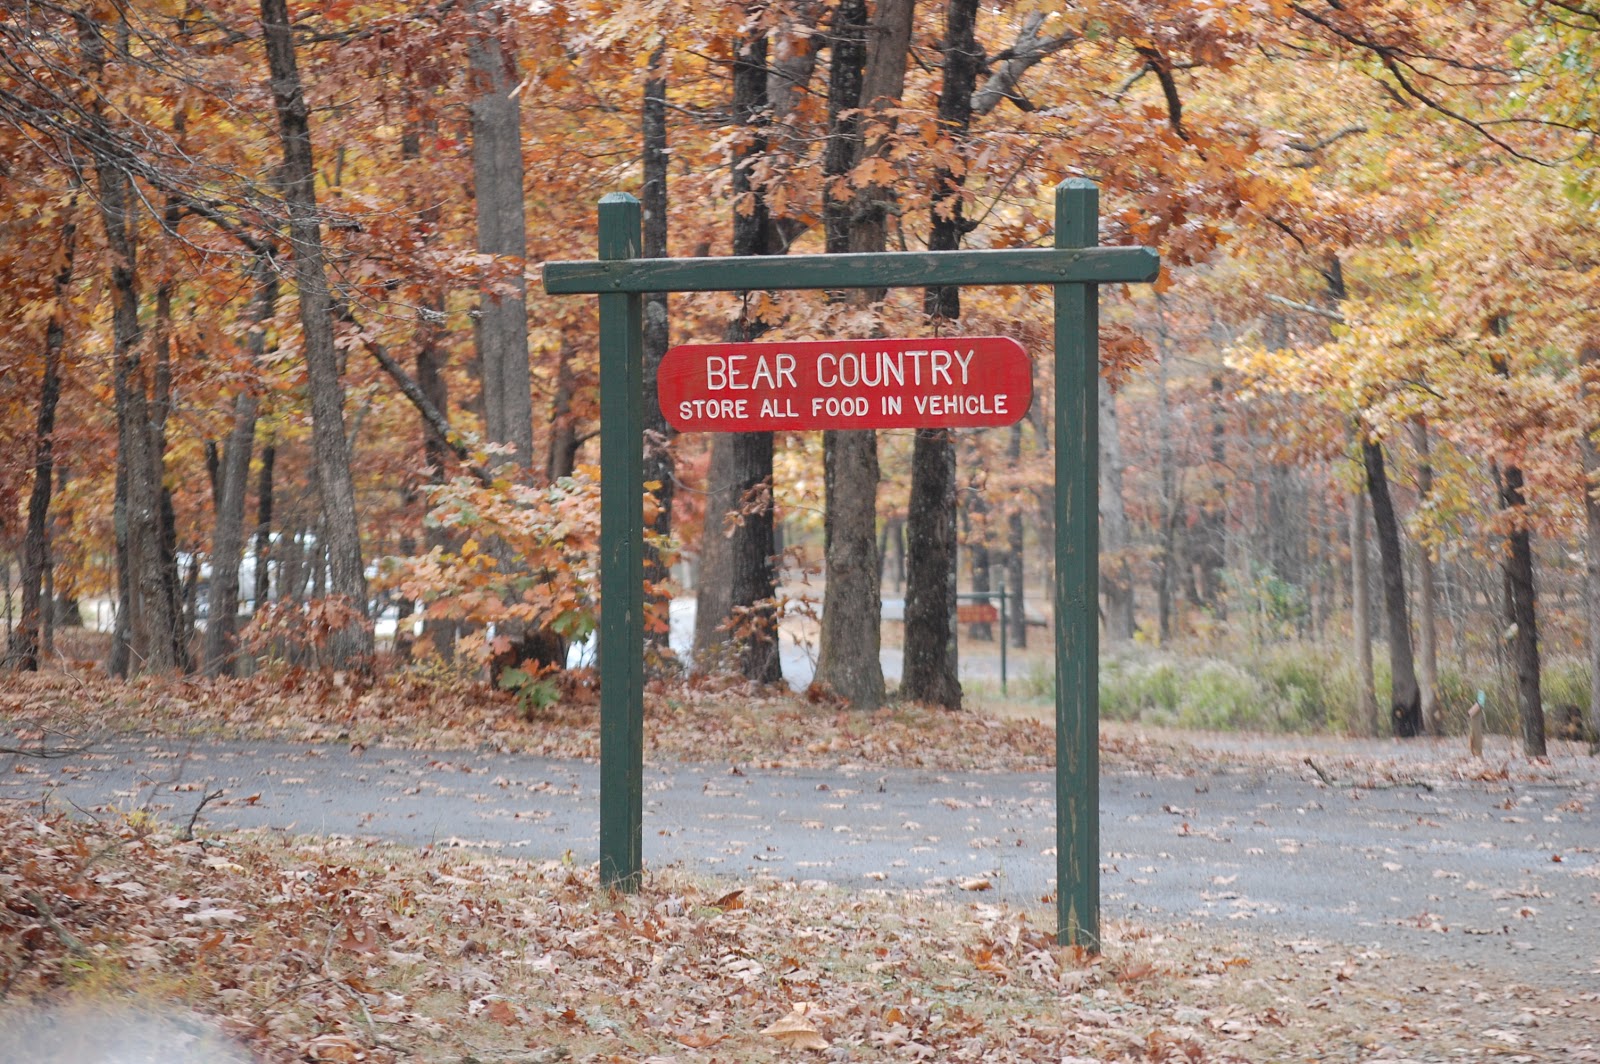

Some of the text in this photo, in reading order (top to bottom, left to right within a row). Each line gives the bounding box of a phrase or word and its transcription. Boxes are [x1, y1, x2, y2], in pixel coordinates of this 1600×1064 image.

[706, 349, 975, 390] BEAR COUNTRY
[679, 394, 1008, 420] STORE ALL FOOD IN VEHICLE
